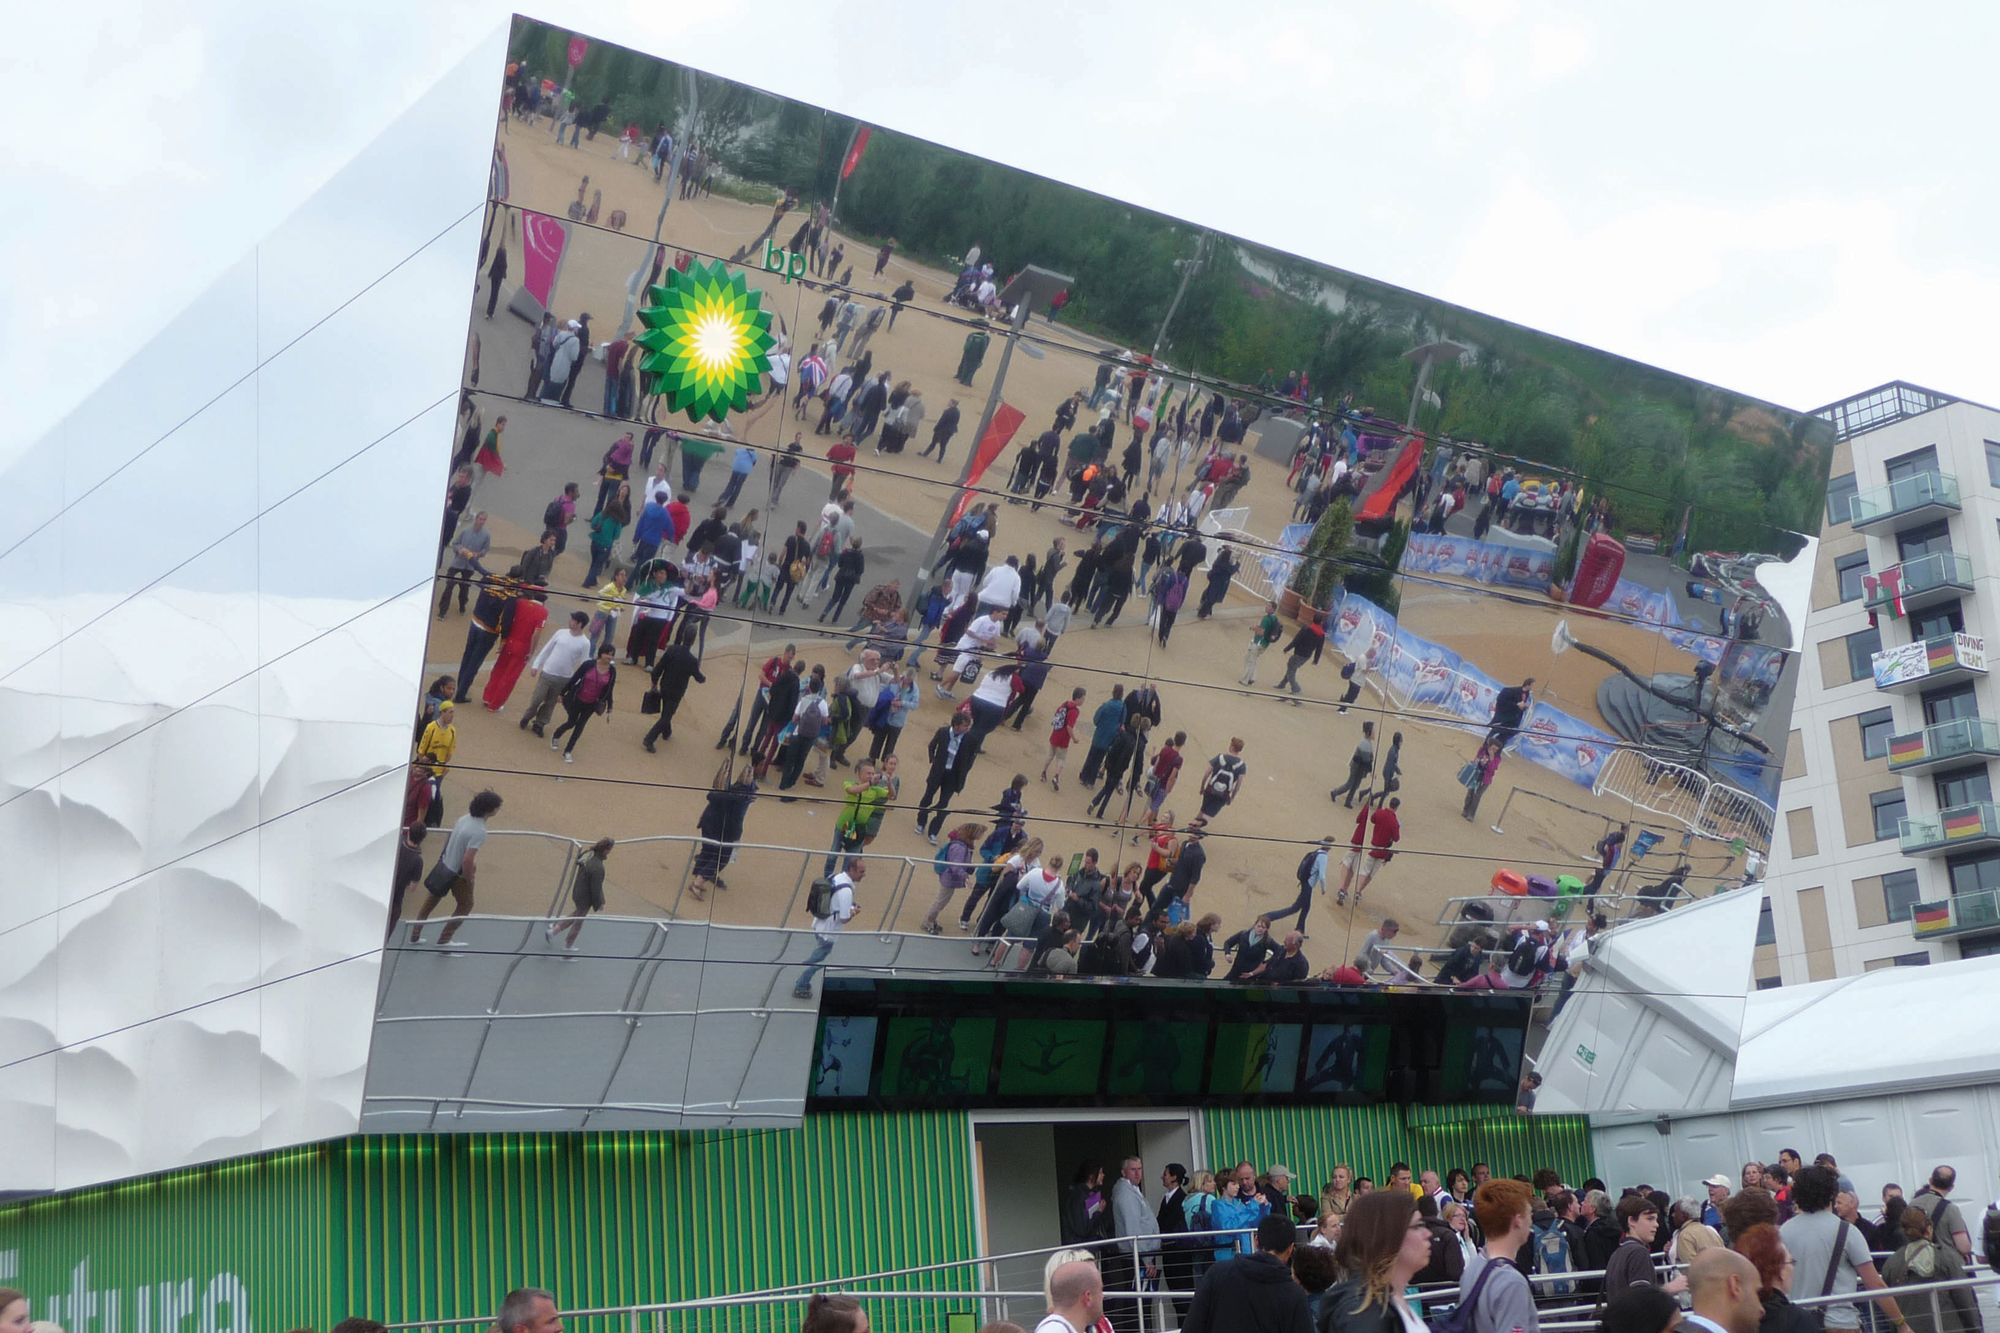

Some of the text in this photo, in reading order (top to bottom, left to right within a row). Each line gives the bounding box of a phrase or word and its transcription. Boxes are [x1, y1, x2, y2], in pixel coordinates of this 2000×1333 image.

[762, 238, 807, 284] bp
[1957, 634, 1984, 651] DIVING
[1961, 651, 1983, 669] TEAM
